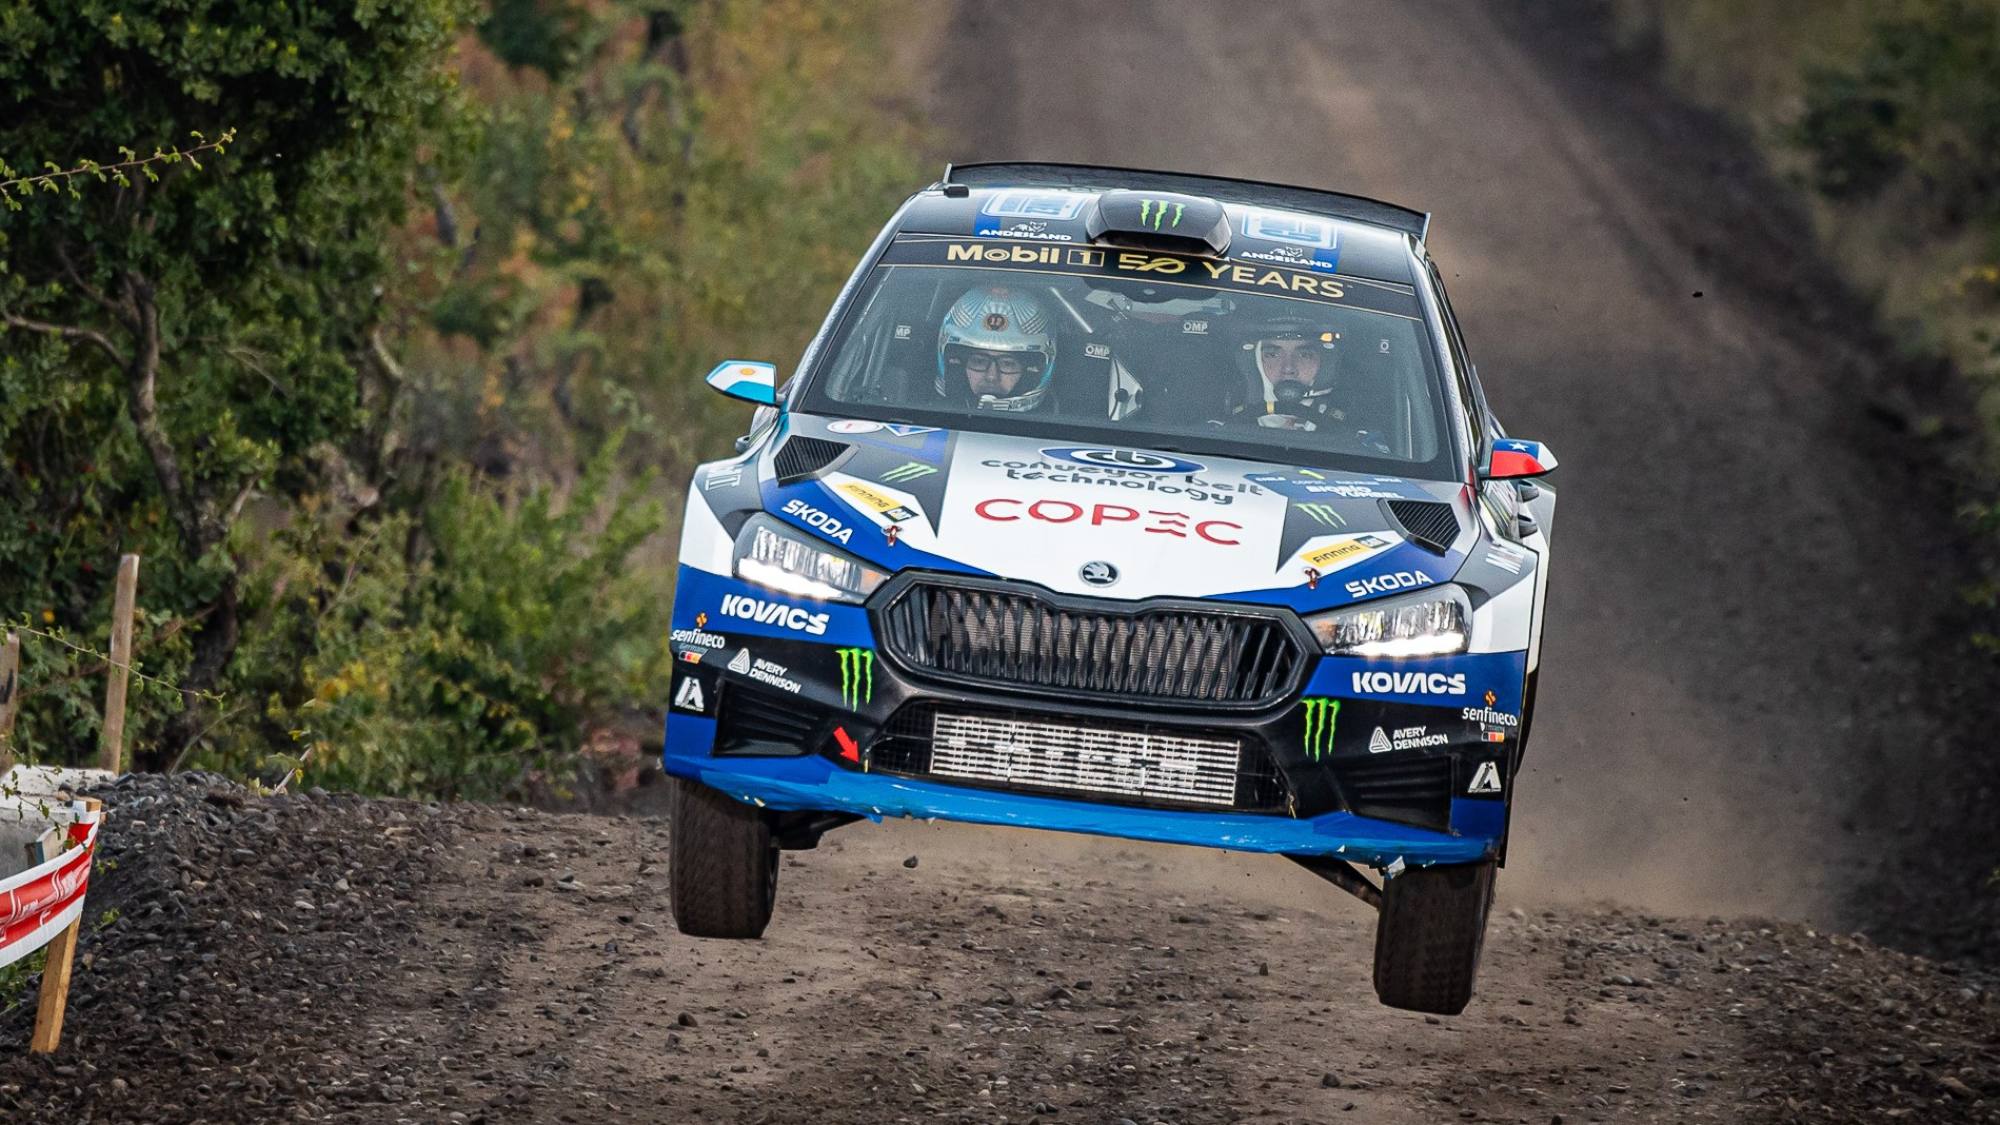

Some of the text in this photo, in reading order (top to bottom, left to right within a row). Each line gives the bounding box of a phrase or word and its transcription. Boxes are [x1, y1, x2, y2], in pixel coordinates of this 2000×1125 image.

[947, 244, 1060, 264] Mobil
[1118, 253, 1186, 274] 50
[1202, 260, 1345, 298] YEARS
[1183, 321, 1208, 332] OMP
[1084, 345, 1110, 357] OMP
[1006, 469, 1234, 505] technology
[975, 498, 1244, 545] COPEC
[720, 594, 830, 635] KOVACS
[670, 628, 726, 649] senfineco
[754, 658, 787, 676] AVERY
[749, 669, 802, 694] DENNISON
[1352, 672, 1466, 695] KOVACS
[1462, 706, 1518, 727] senfineco
[1393, 726, 1426, 738] AVERY
[1393, 733, 1449, 751] DENNISON
